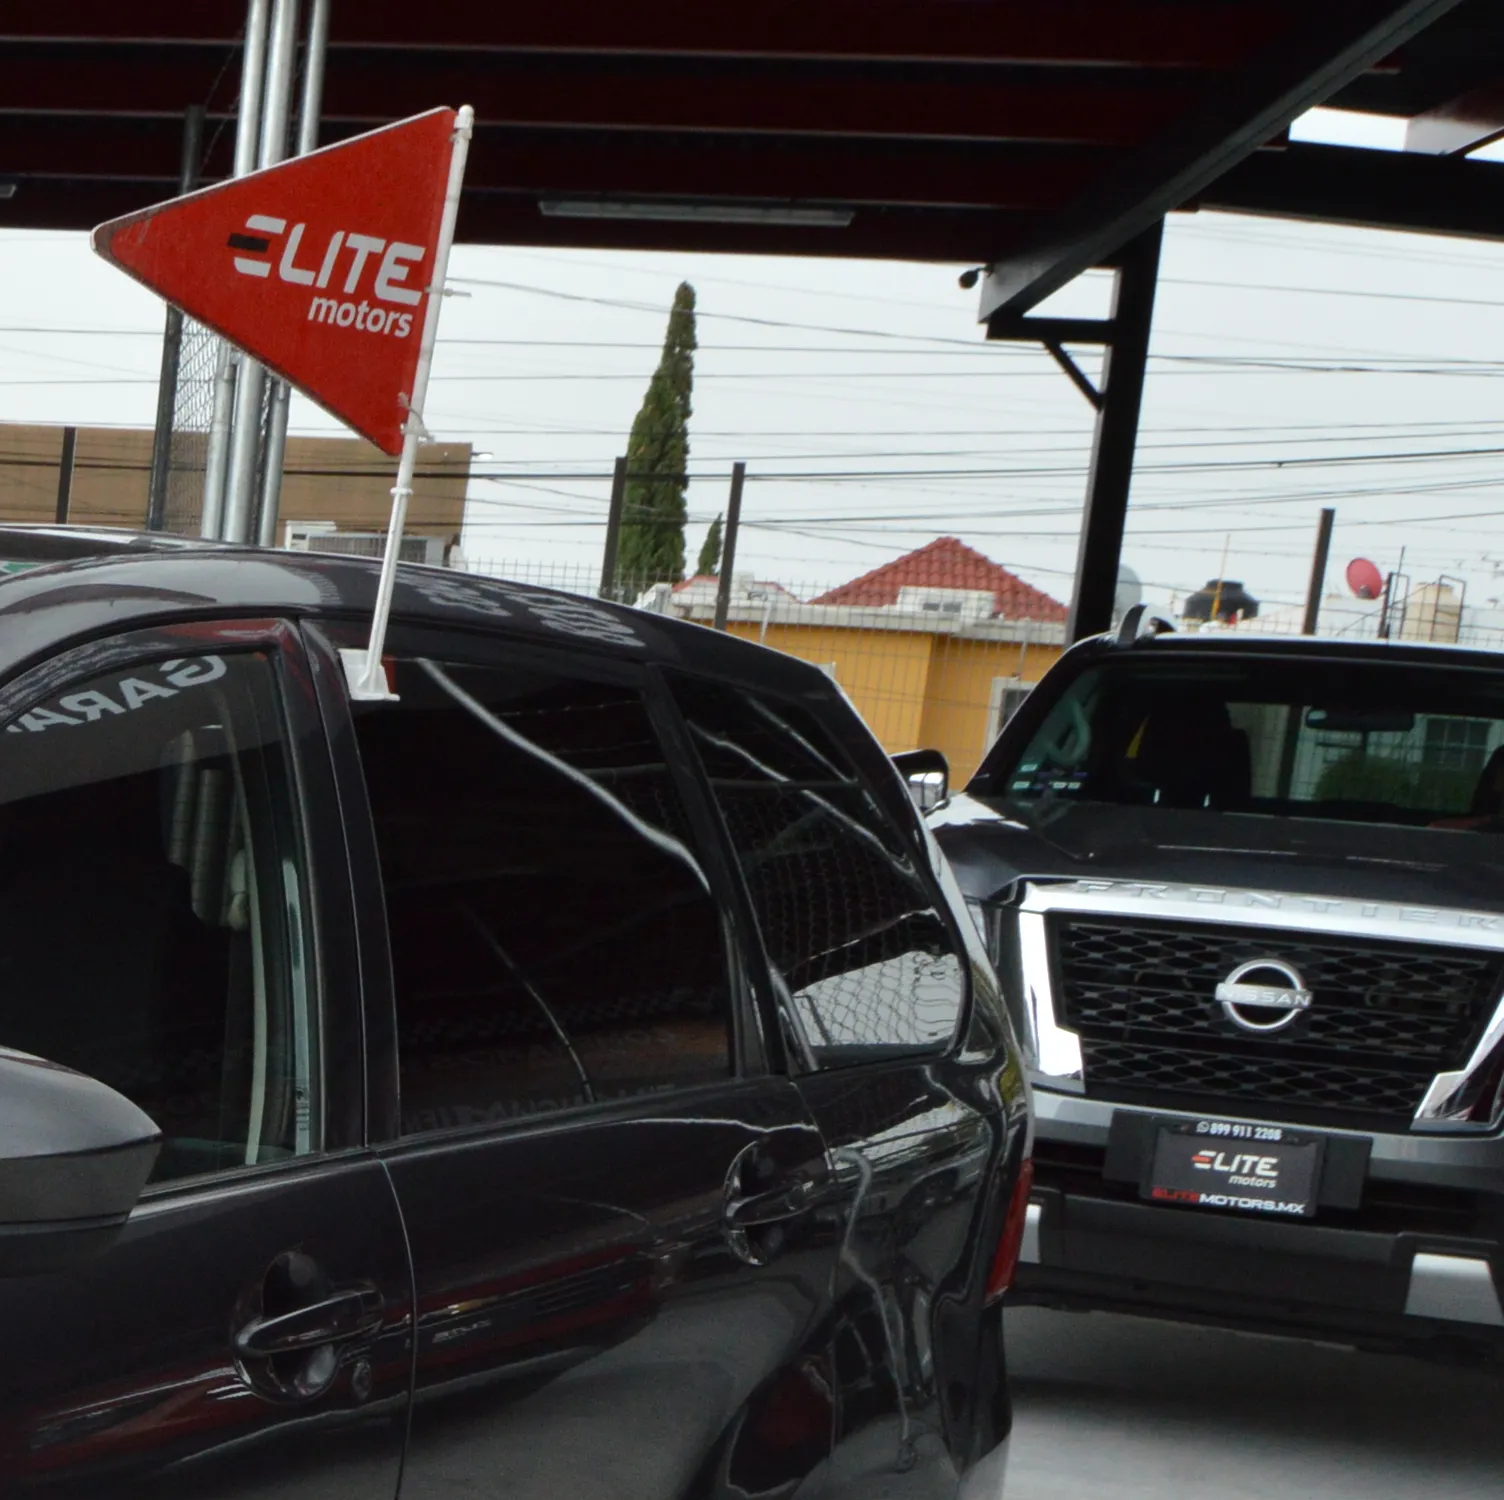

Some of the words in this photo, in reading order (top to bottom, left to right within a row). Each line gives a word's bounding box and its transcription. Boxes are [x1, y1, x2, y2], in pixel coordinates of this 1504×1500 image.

[227, 214, 427, 306] ELITE
[307, 296, 413, 338] motors
[1219, 986, 1312, 1007] NISSAN
[1192, 1149, 1279, 1177] ELITE
[1228, 1175, 1277, 1188] motors
